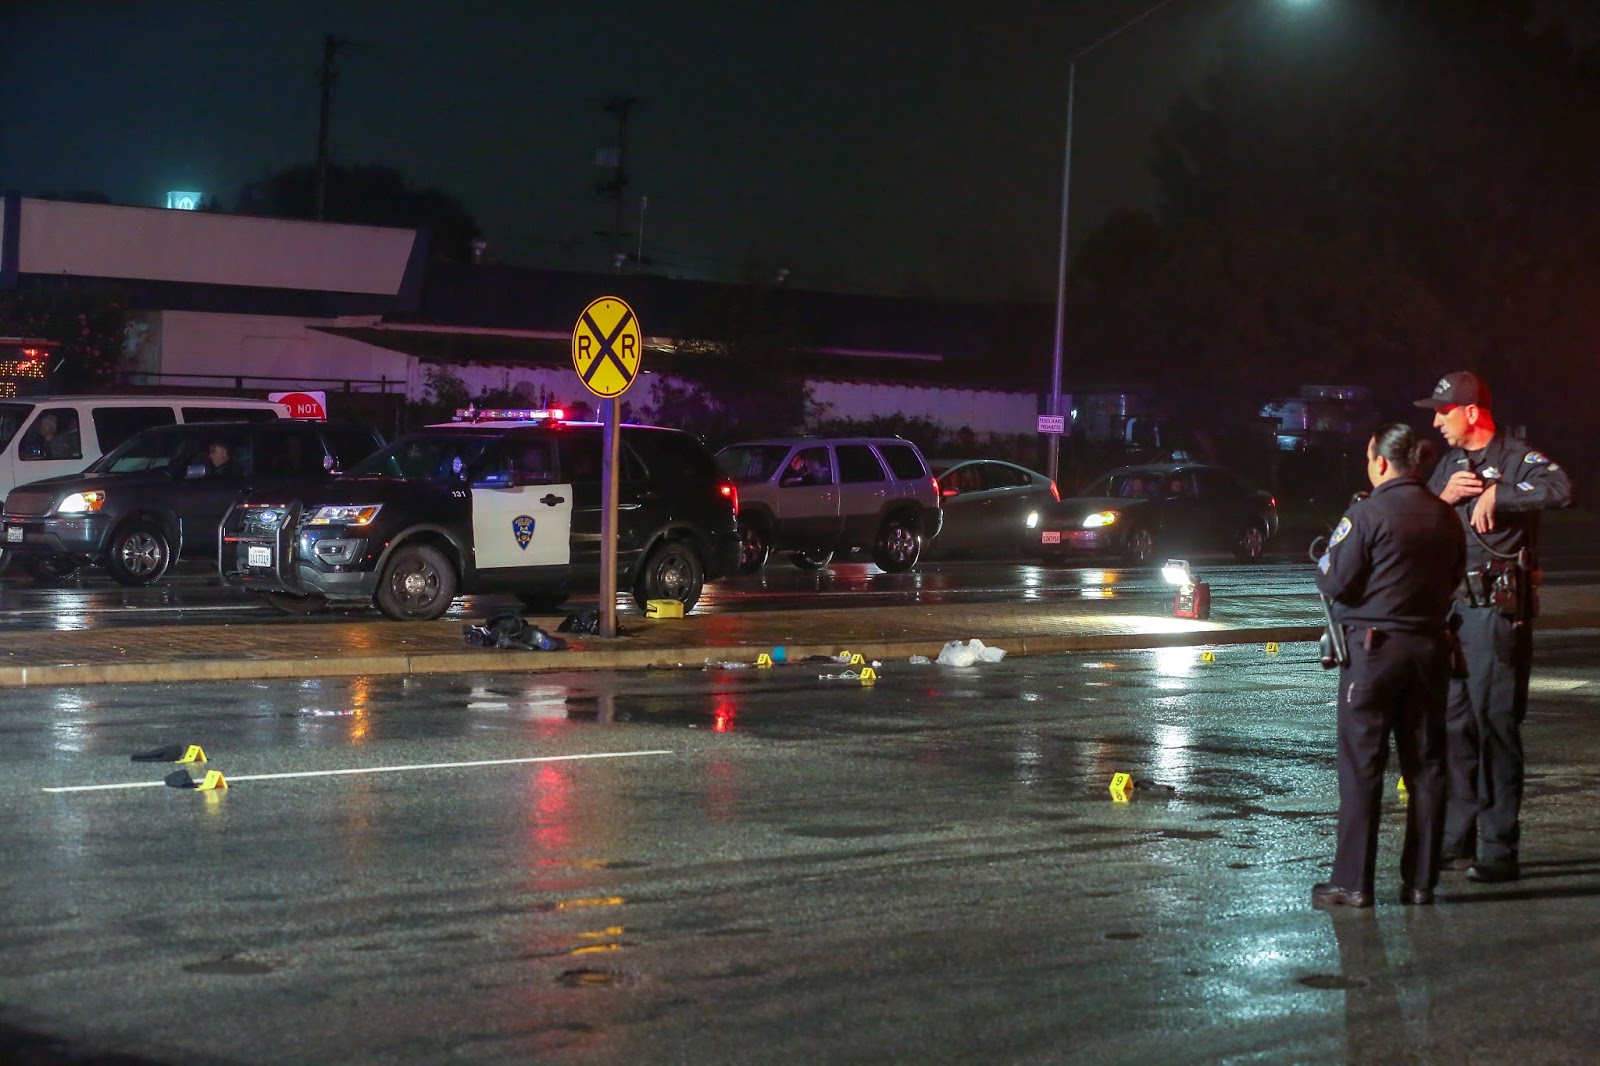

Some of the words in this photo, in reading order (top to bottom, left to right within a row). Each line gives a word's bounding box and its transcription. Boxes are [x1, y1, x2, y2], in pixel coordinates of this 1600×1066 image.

[578, 336, 591, 360] R
[622, 334, 635, 358] R
[297, 403, 318, 414] NOT
[452, 490, 466, 498] 131
[862, 668, 868, 676] 3
[1116, 776, 1124, 786] 9
